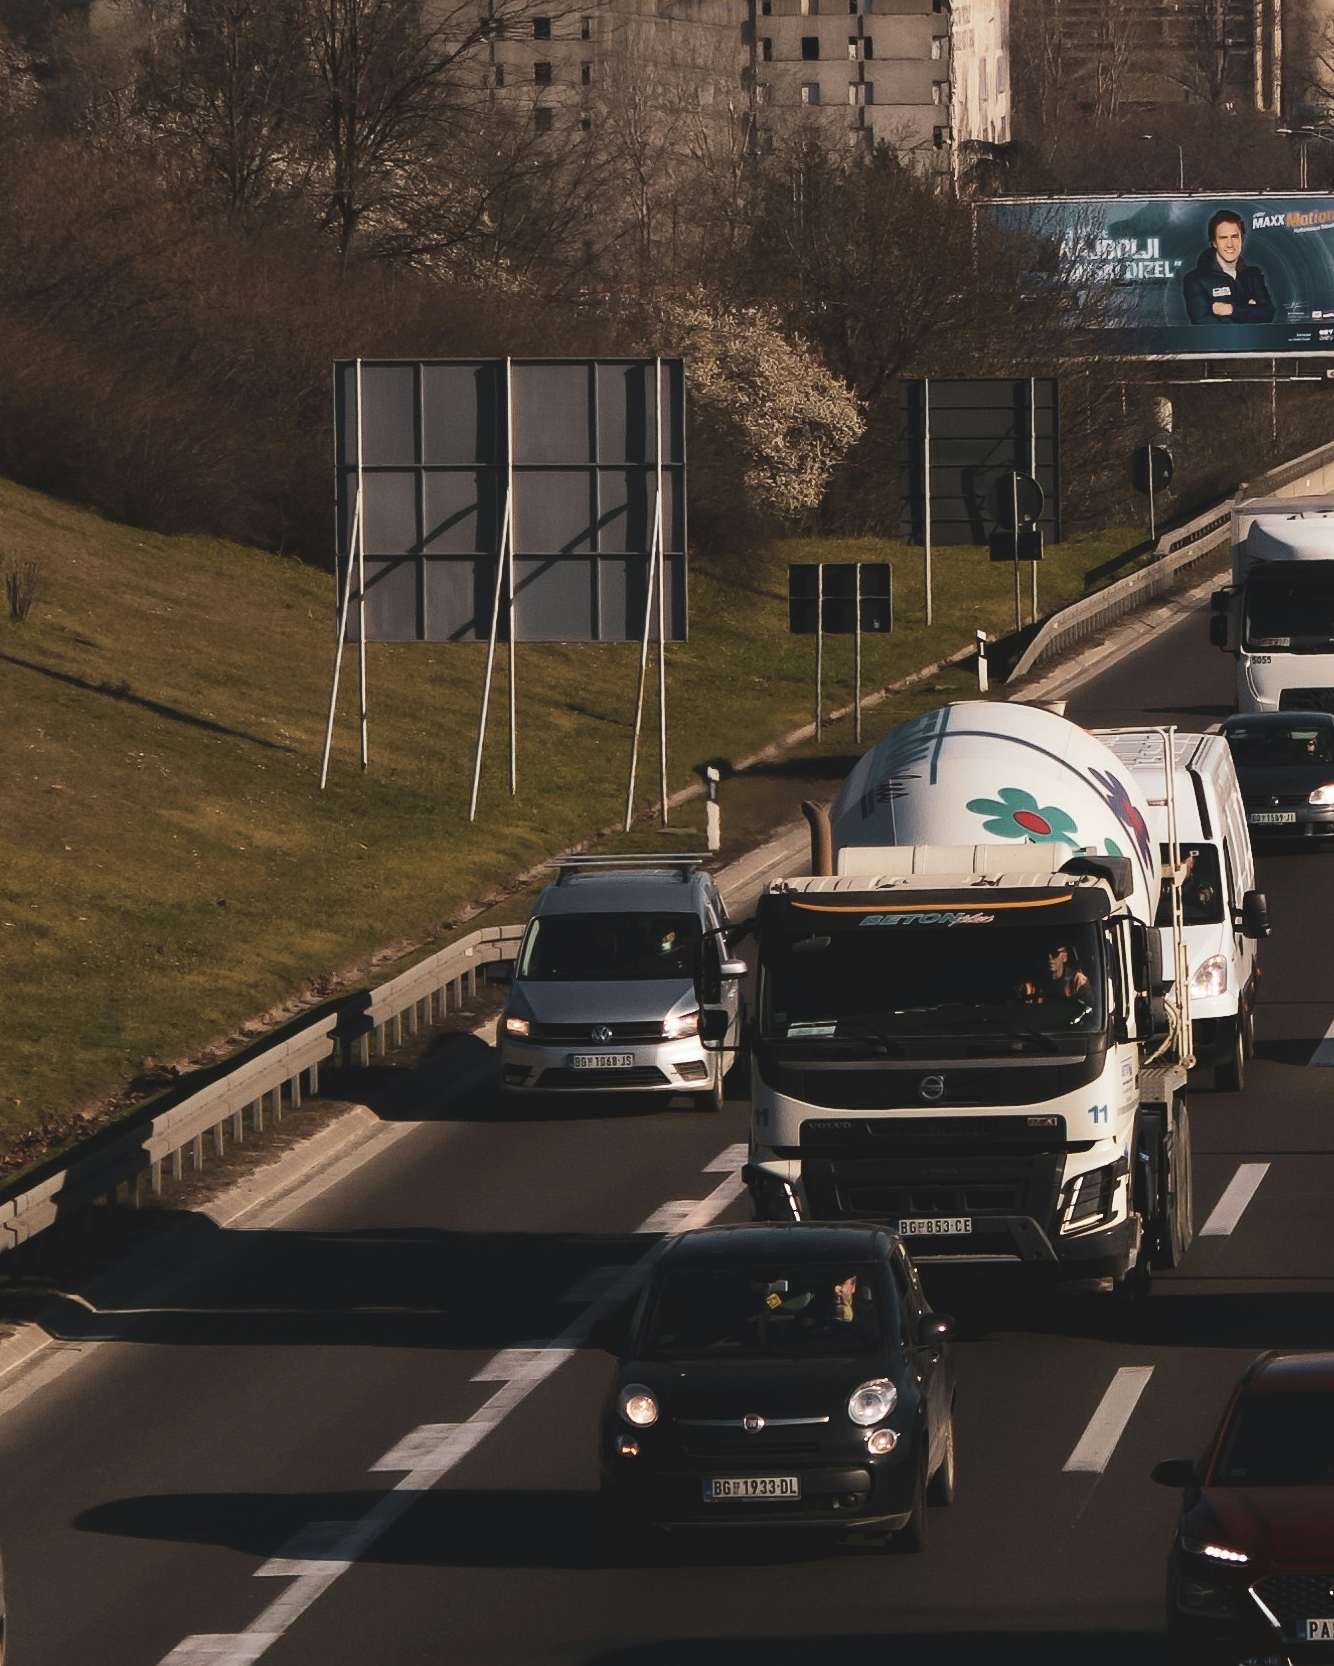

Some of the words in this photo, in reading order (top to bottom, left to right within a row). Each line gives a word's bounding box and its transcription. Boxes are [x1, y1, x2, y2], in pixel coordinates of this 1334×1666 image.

[1087, 1104, 1109, 1124] 11
[900, 1221, 917, 1234] BG
[714, 1480, 731, 1496] BG
[1308, 1621, 1331, 1639] PA
